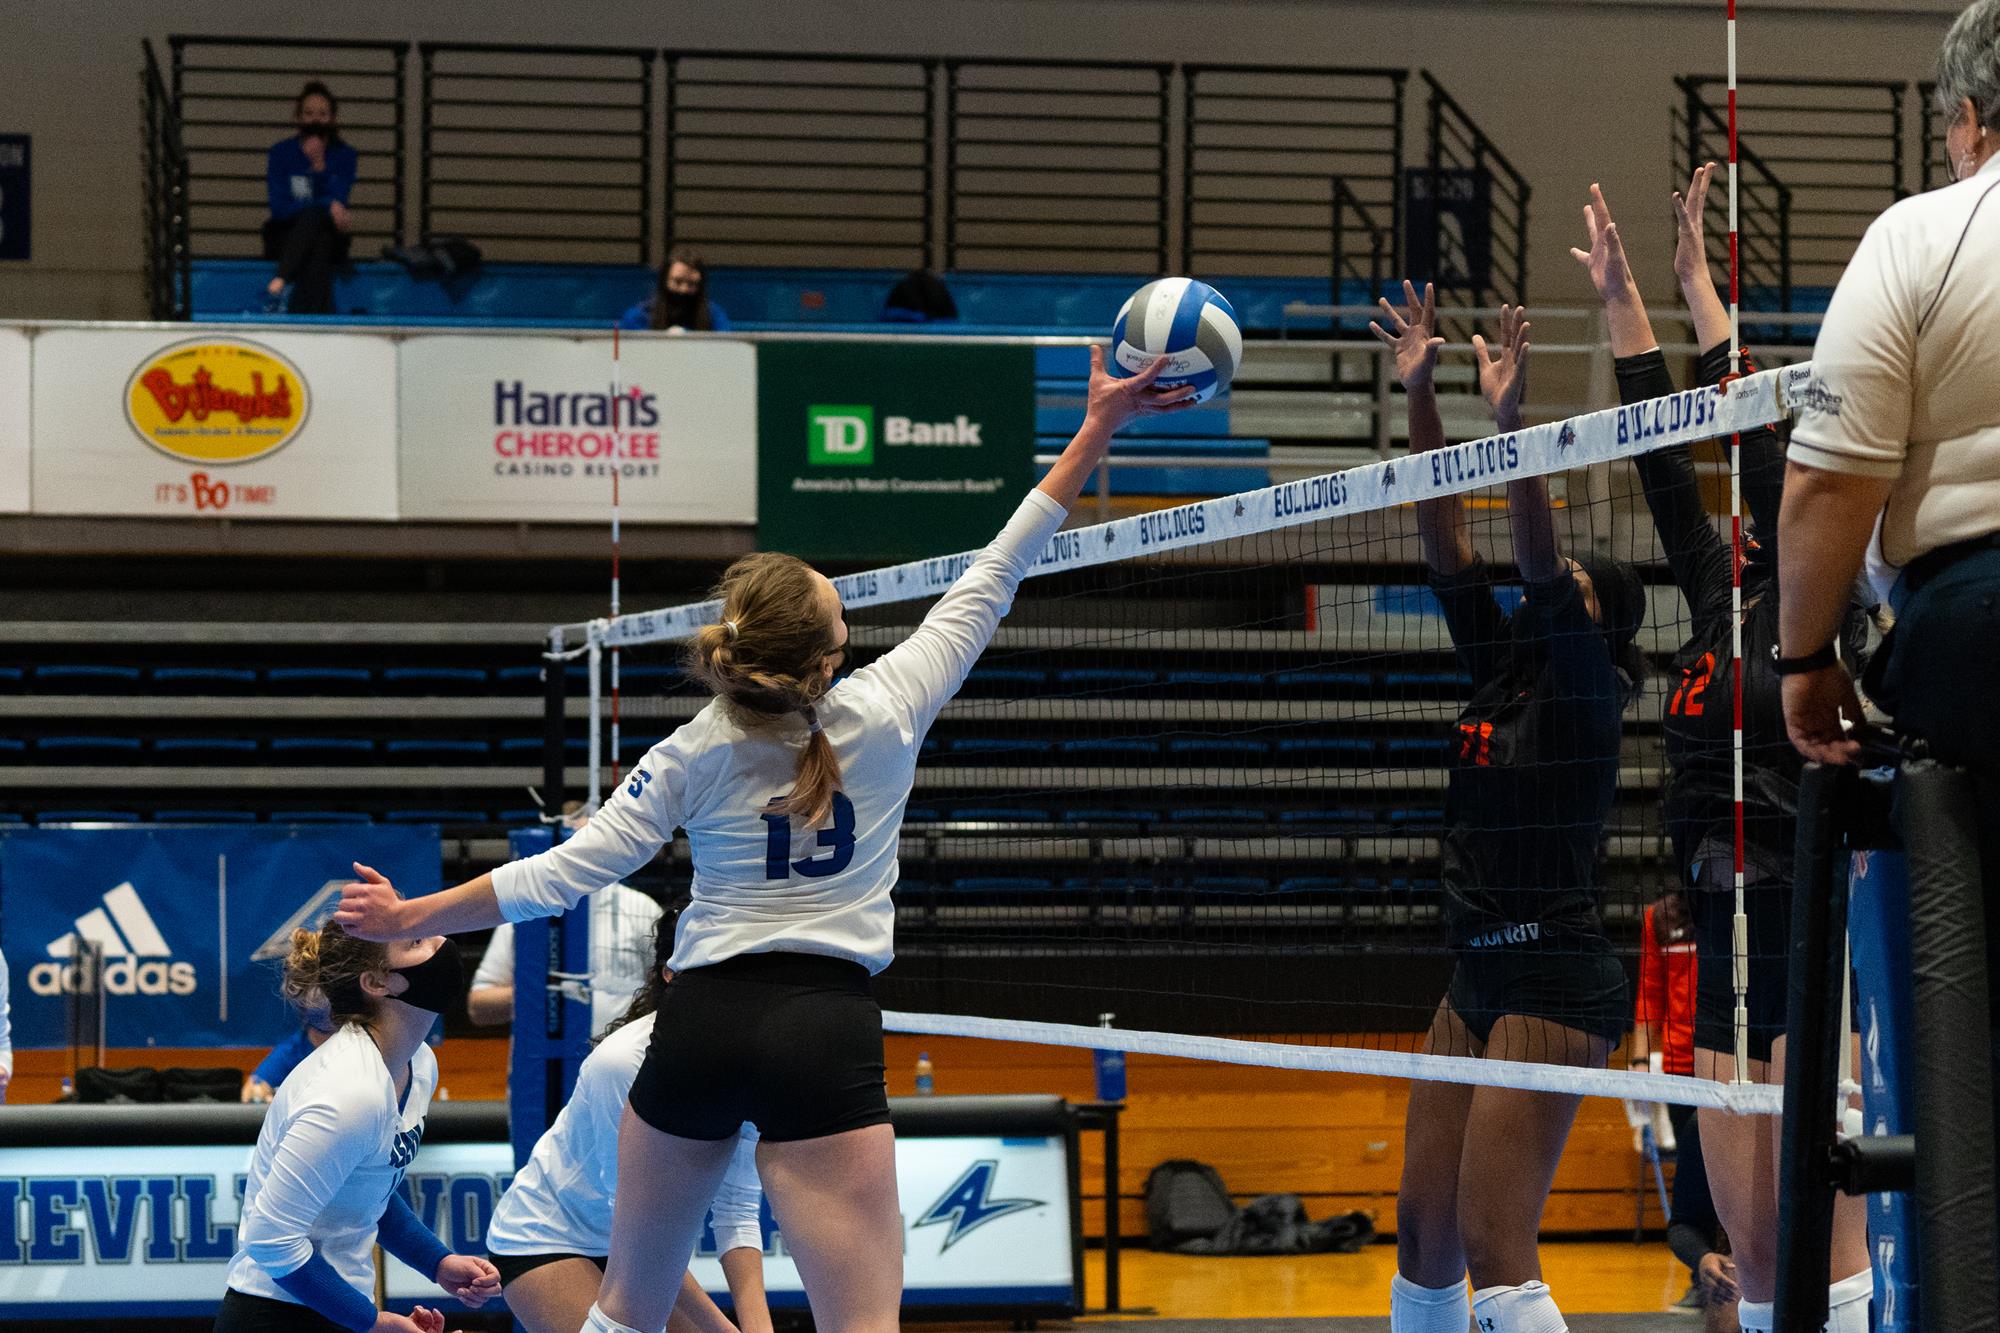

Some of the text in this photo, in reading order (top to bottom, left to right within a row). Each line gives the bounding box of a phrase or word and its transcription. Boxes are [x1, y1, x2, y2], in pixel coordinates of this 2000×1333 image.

[495, 432, 660, 459] CHEROKEE
[815, 415, 983, 454] TD Bank
[494, 463, 573, 476] CASINO
[1431, 435, 1518, 486] BULLDOGS
[760, 790, 856, 881] 13
[28, 952, 197, 996] addas
